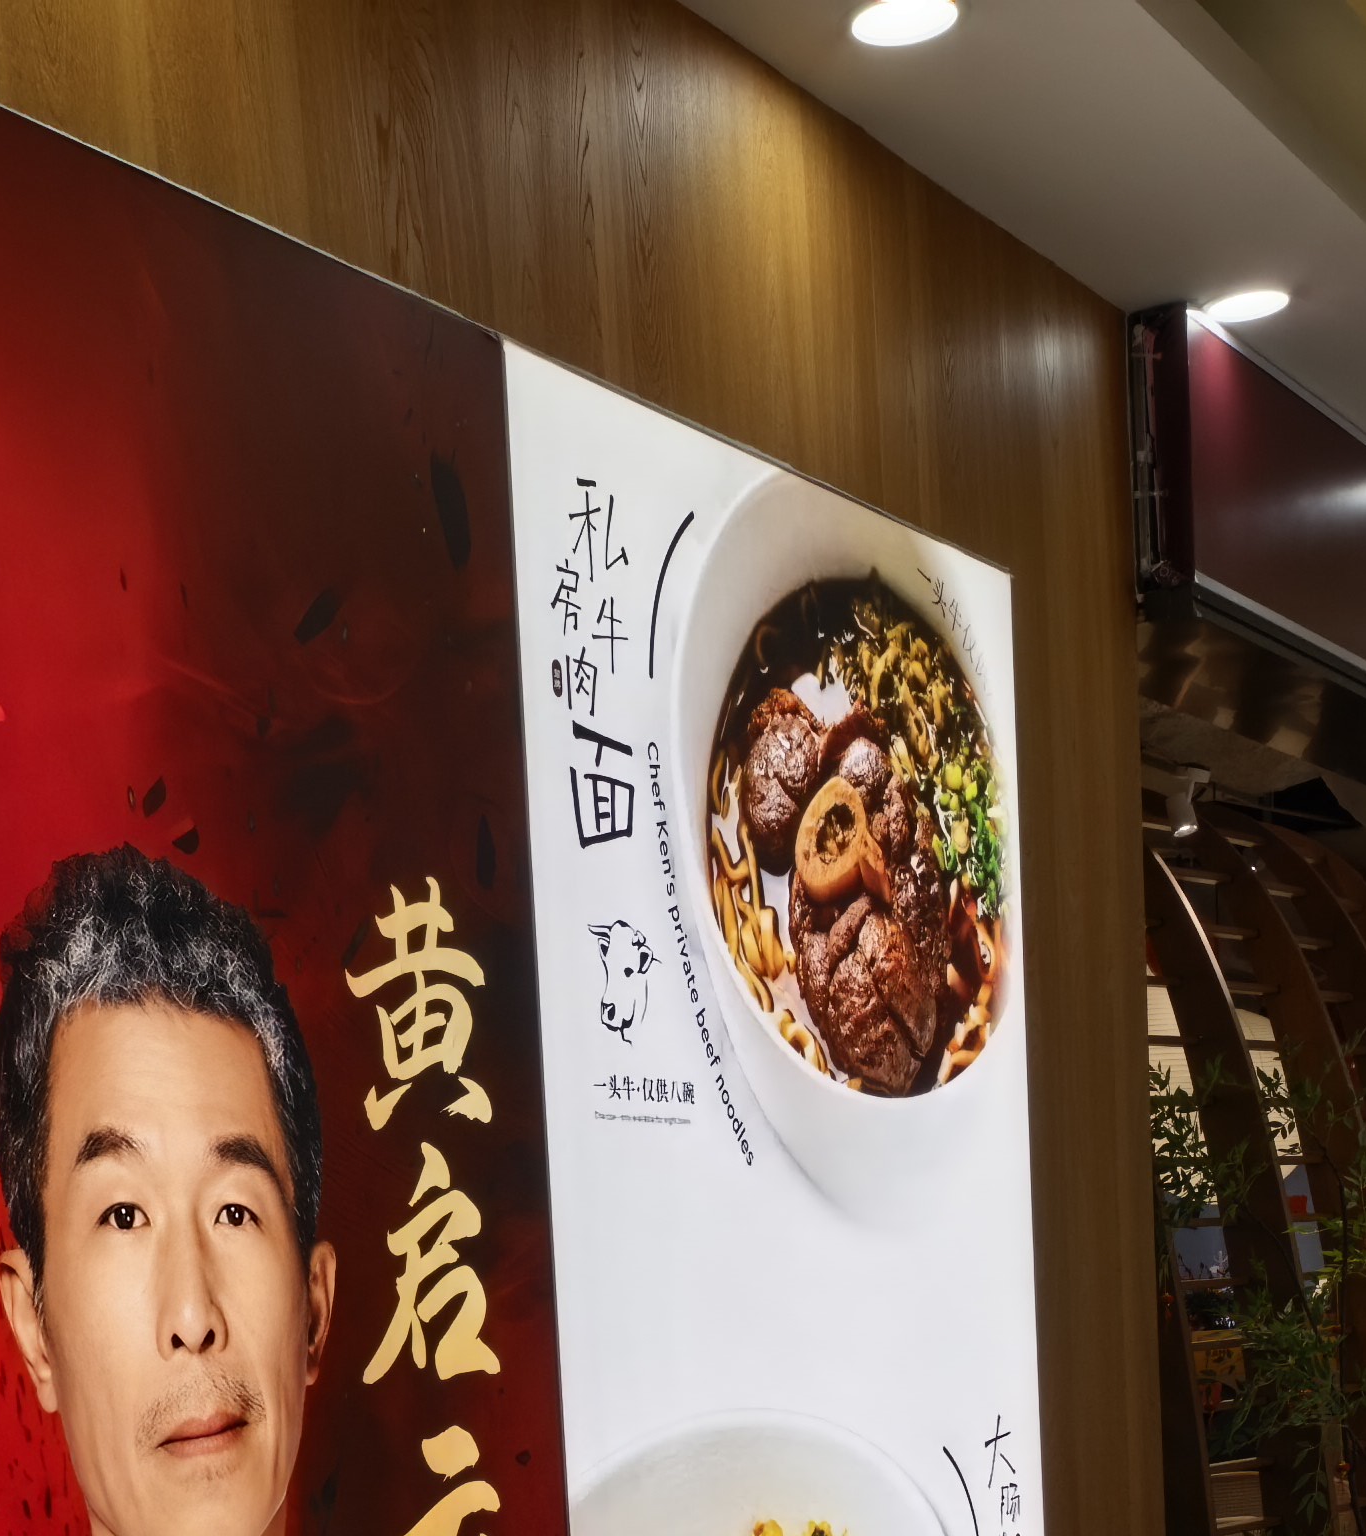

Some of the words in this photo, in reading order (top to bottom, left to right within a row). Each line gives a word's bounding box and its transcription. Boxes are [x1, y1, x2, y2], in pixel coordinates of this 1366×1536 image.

[647, 741, 666, 811] Chef
[655, 821, 676, 894] Ken's
[667, 904, 699, 1004] private
[695, 1011, 721, 1068] beef
[715, 1073, 754, 1167] noodles
